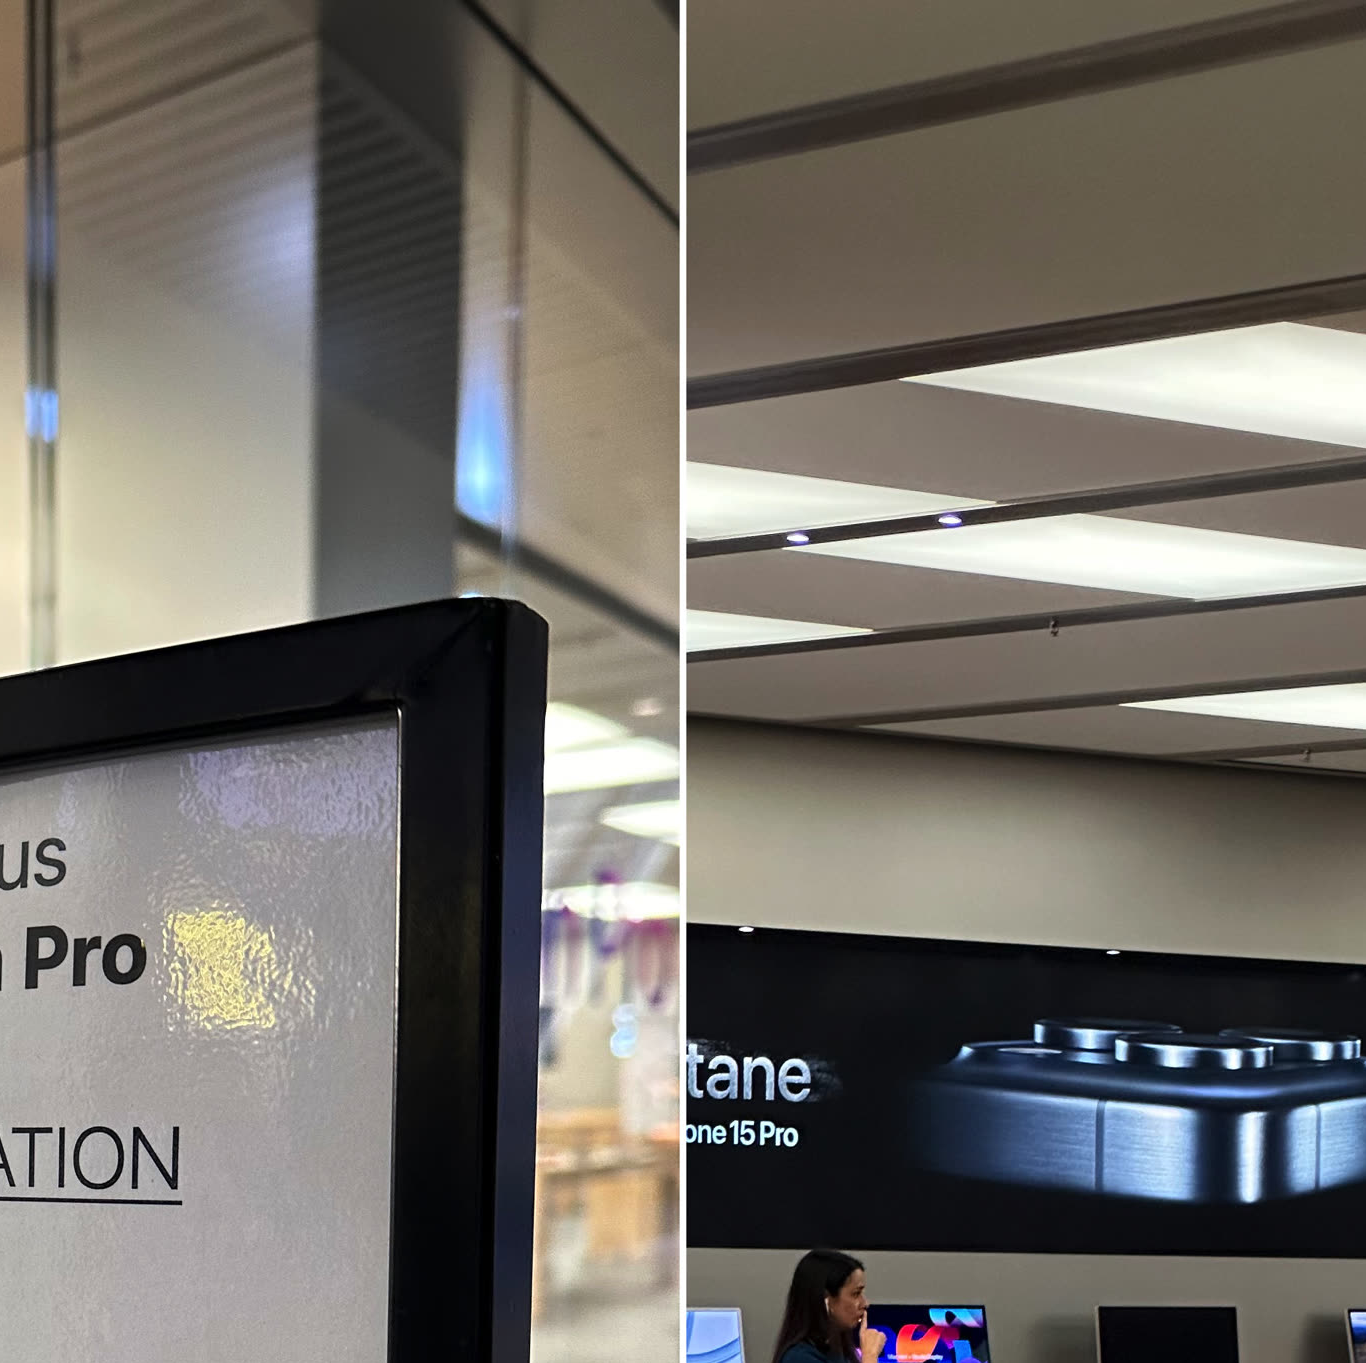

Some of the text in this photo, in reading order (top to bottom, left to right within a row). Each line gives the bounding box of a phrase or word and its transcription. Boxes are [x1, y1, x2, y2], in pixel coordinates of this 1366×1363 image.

[24, 925, 148, 990] Pro
[686, 1042, 812, 1103] tane
[729, 1119, 756, 1146] 15
[759, 1120, 799, 1147] Pro
